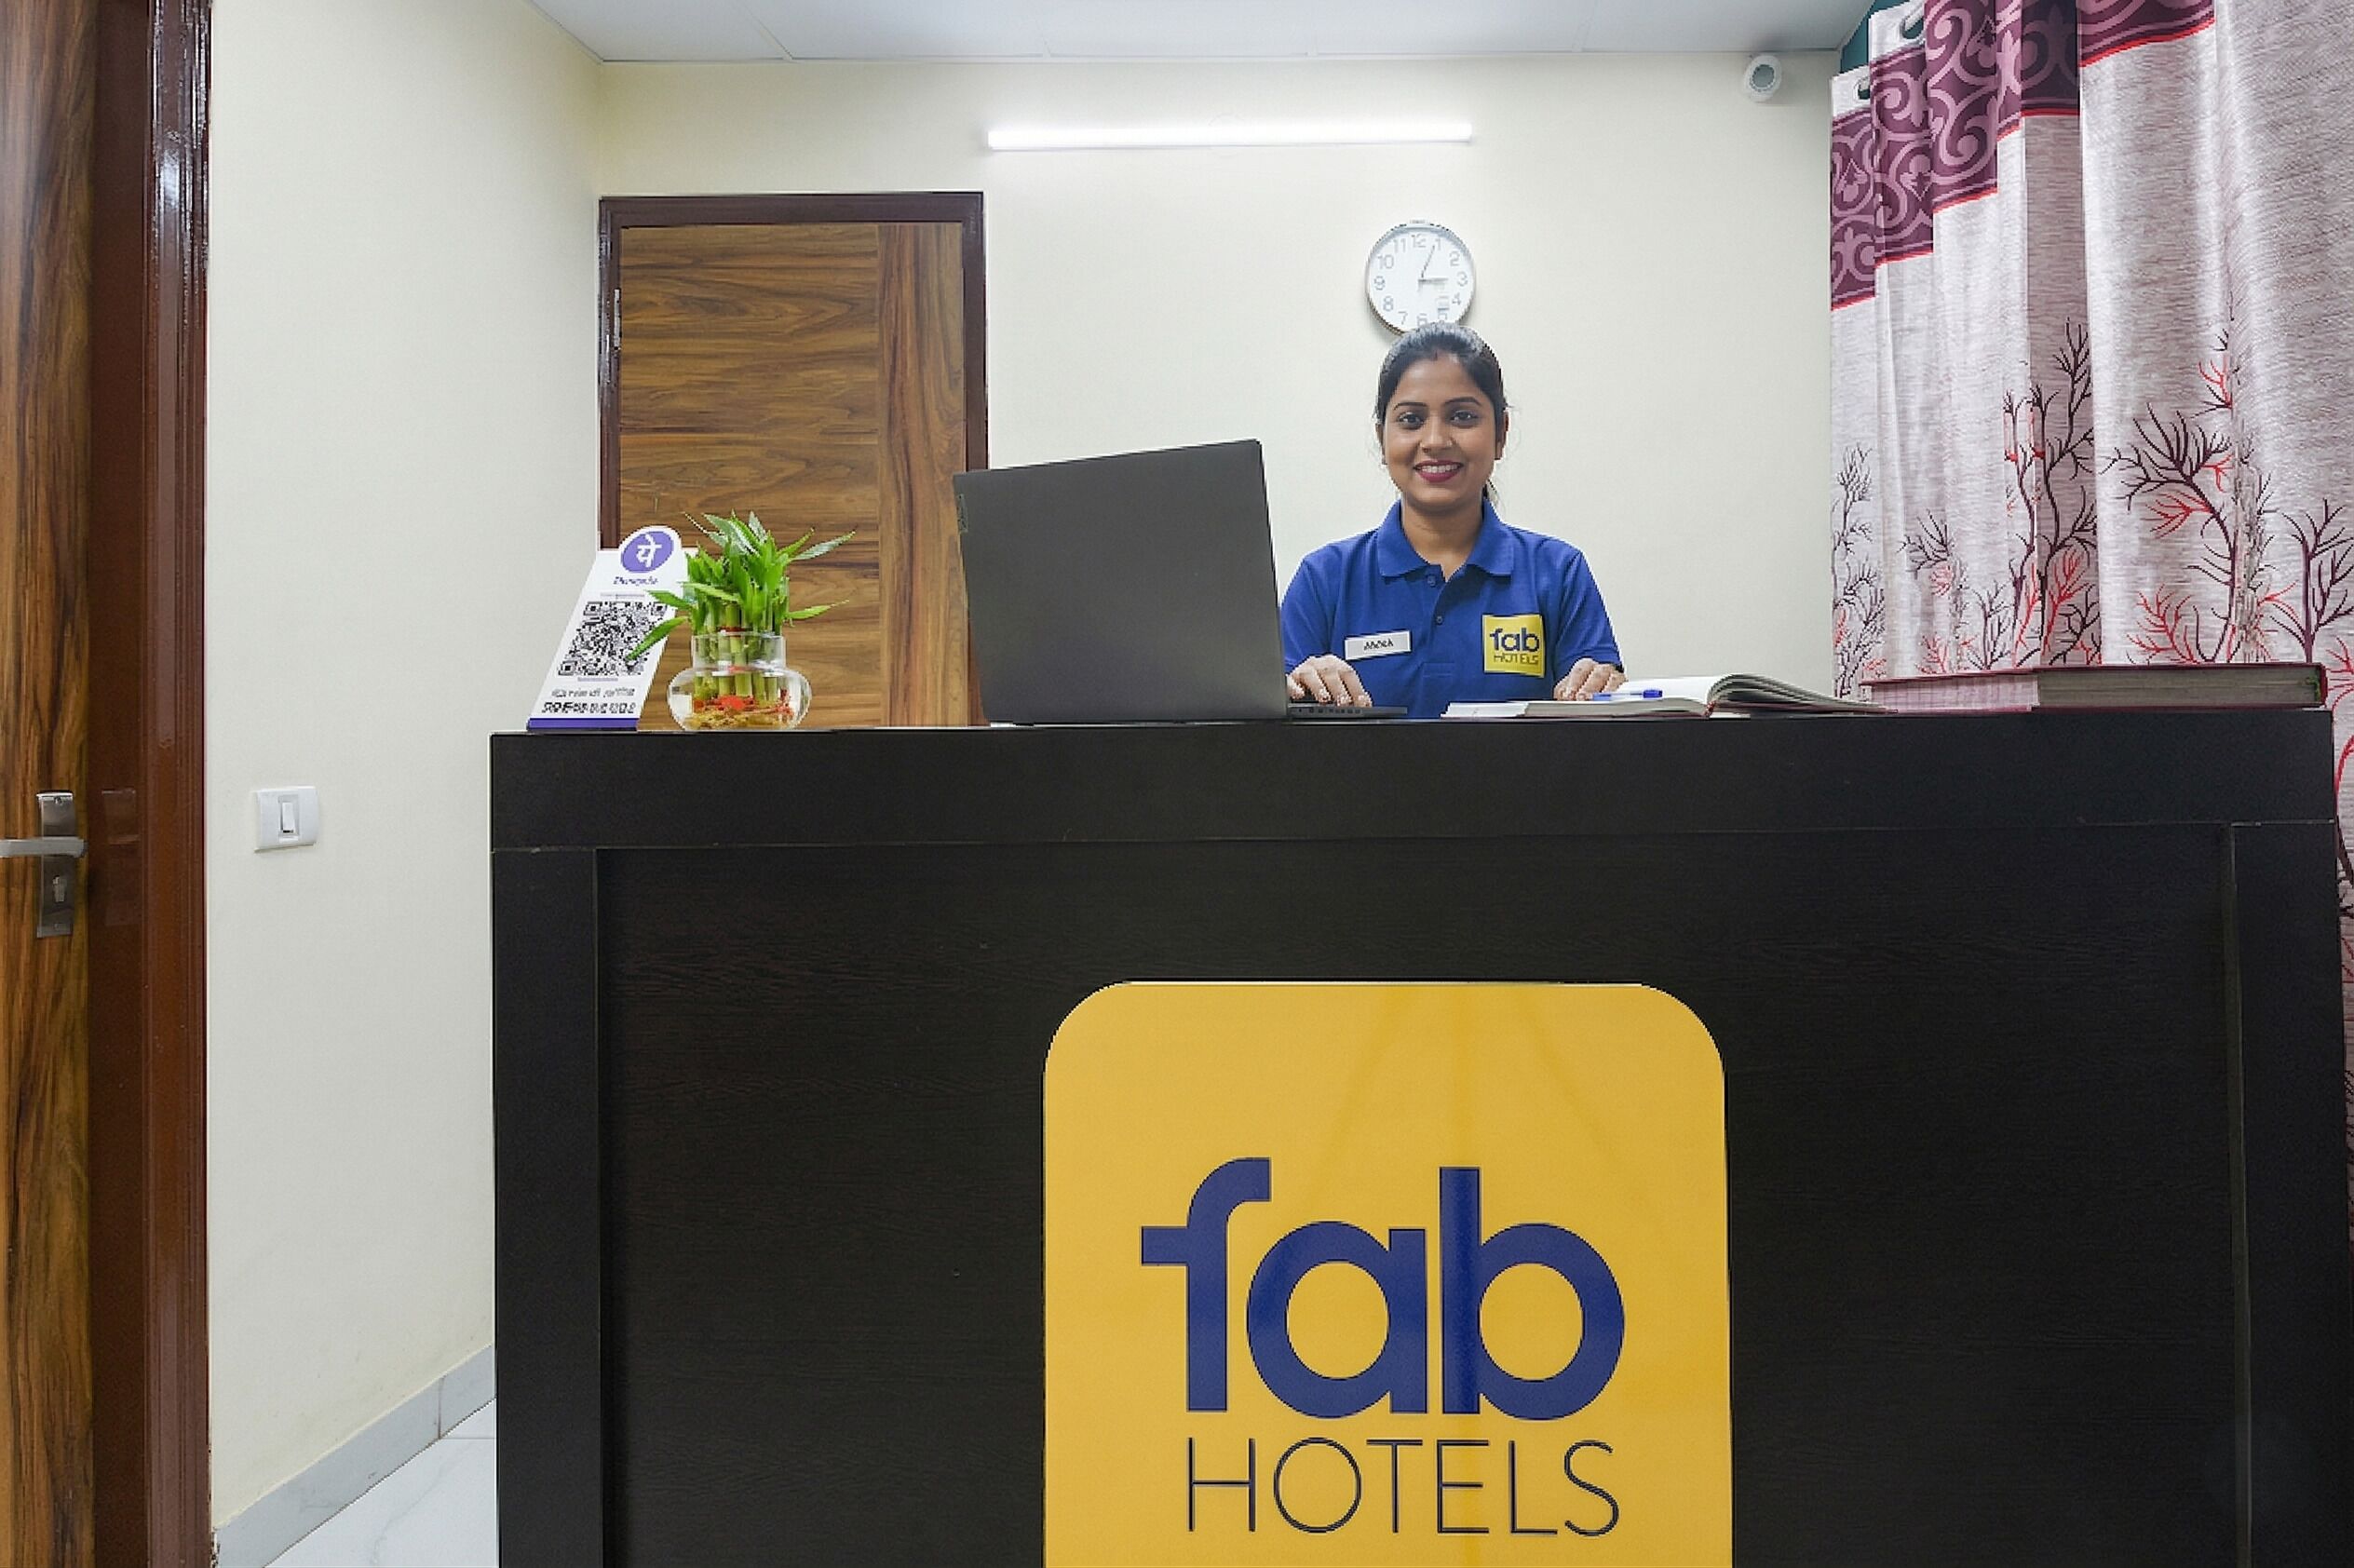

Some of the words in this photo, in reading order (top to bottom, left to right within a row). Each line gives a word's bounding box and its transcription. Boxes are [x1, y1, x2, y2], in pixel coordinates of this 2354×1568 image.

[1393, 237, 1406, 253] 11
[1411, 234, 1427, 248] 12
[1435, 238, 1441, 250] 1
[1377, 254, 1394, 269] 10
[1449, 251, 1460, 266] 2
[1373, 276, 1386, 291] 9
[1456, 271, 1468, 287] 3
[1383, 295, 1394, 312] 8
[1452, 291, 1462, 305] 4
[1398, 311, 1408, 325] 7
[1438, 307, 1449, 322] 5
[1490, 627, 1540, 652] fab
[1494, 653, 1539, 665] HOTELS
[1142, 1157, 1625, 1420] fab
[1187, 1437, 1620, 1536] HOTELS
